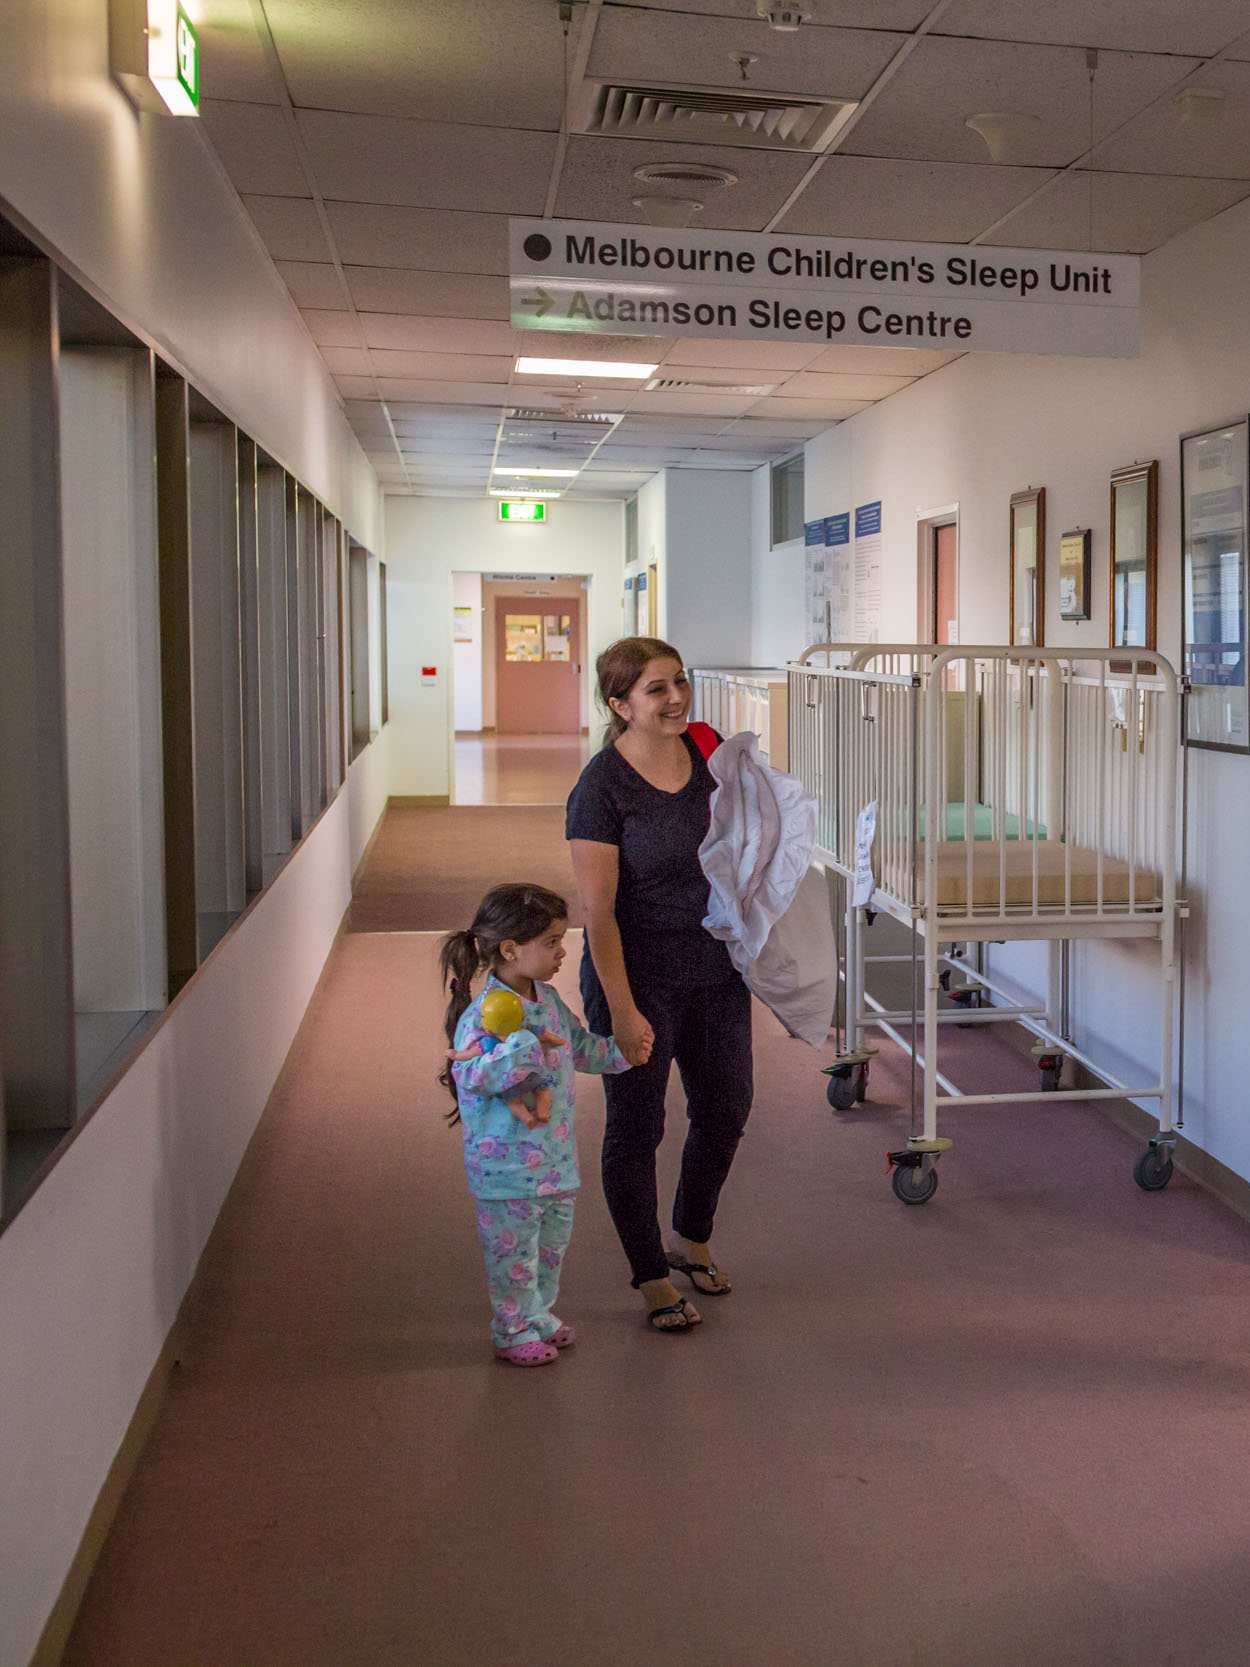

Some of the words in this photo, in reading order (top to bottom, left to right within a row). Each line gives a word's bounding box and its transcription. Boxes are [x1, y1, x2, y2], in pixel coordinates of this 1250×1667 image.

[565, 235, 756, 274] Melbourne
[767, 246, 935, 285] Children's
[947, 257, 1040, 297] Sleep
[1049, 264, 1113, 294] Unit
[566, 290, 737, 327] Adamson
[748, 299, 847, 339] Sleep
[857, 305, 973, 339] Centre
